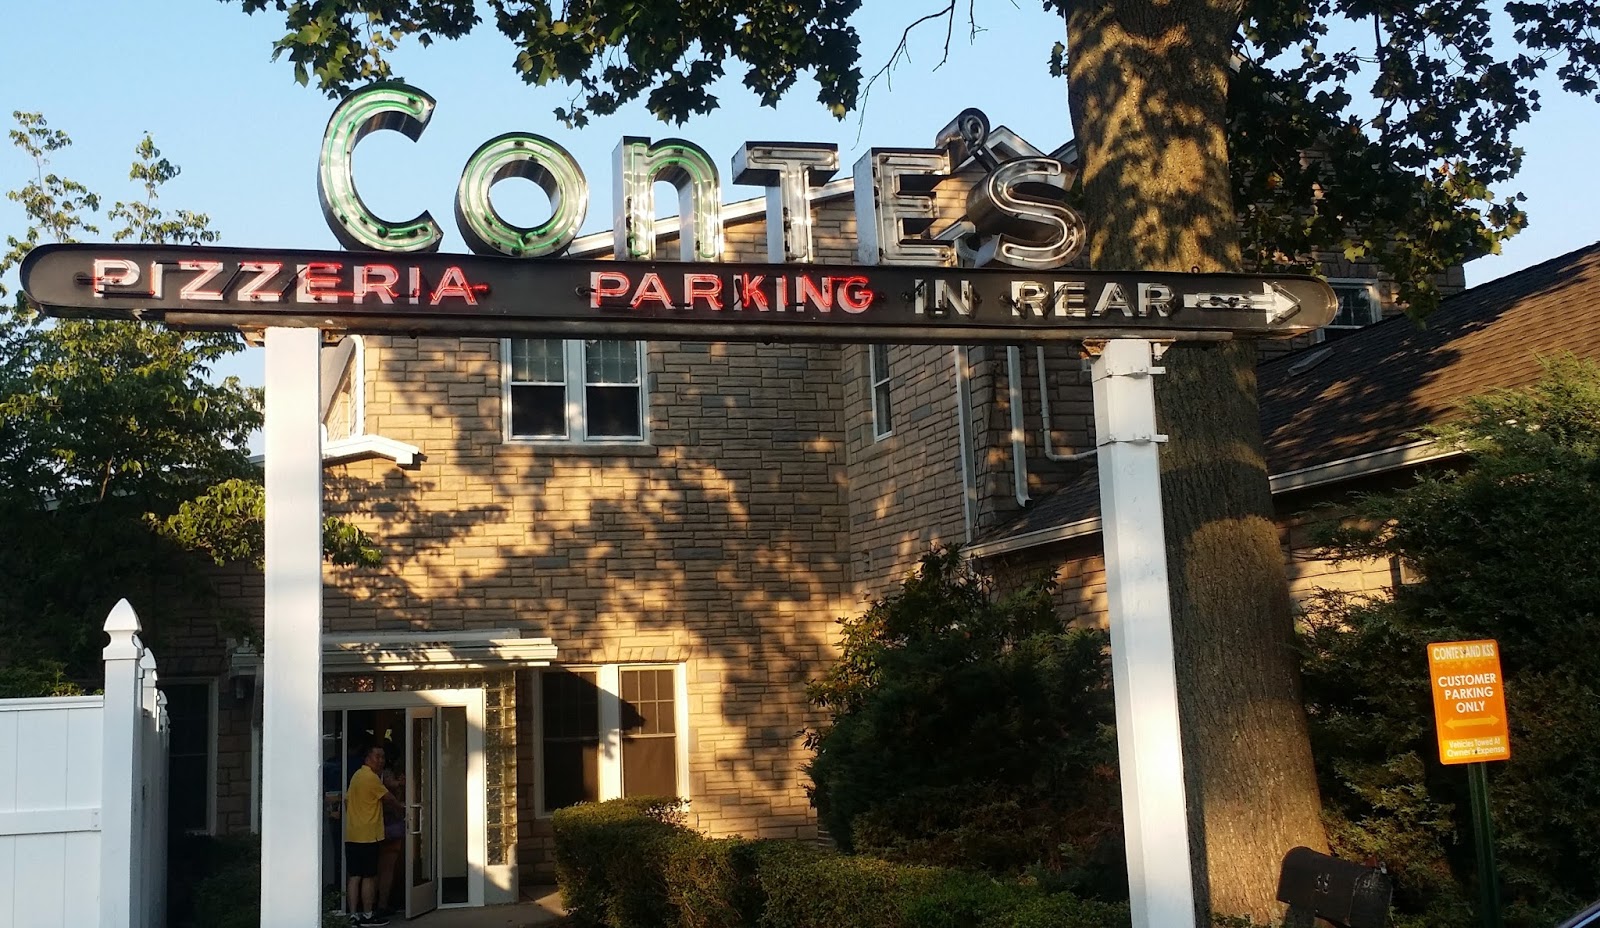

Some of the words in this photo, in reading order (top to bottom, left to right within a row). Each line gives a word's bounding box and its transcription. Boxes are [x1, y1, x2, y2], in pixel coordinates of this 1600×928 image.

[93, 258, 479, 306] PIZZERIA
[588, 271, 874, 313] PARKING
[914, 278, 974, 316] IN
[1010, 280, 1175, 318] REAR
[1438, 673, 1496, 687] CUSTOMER
[1445, 686, 1493, 700] PARKING
[1456, 701, 1486, 714] ONLY
